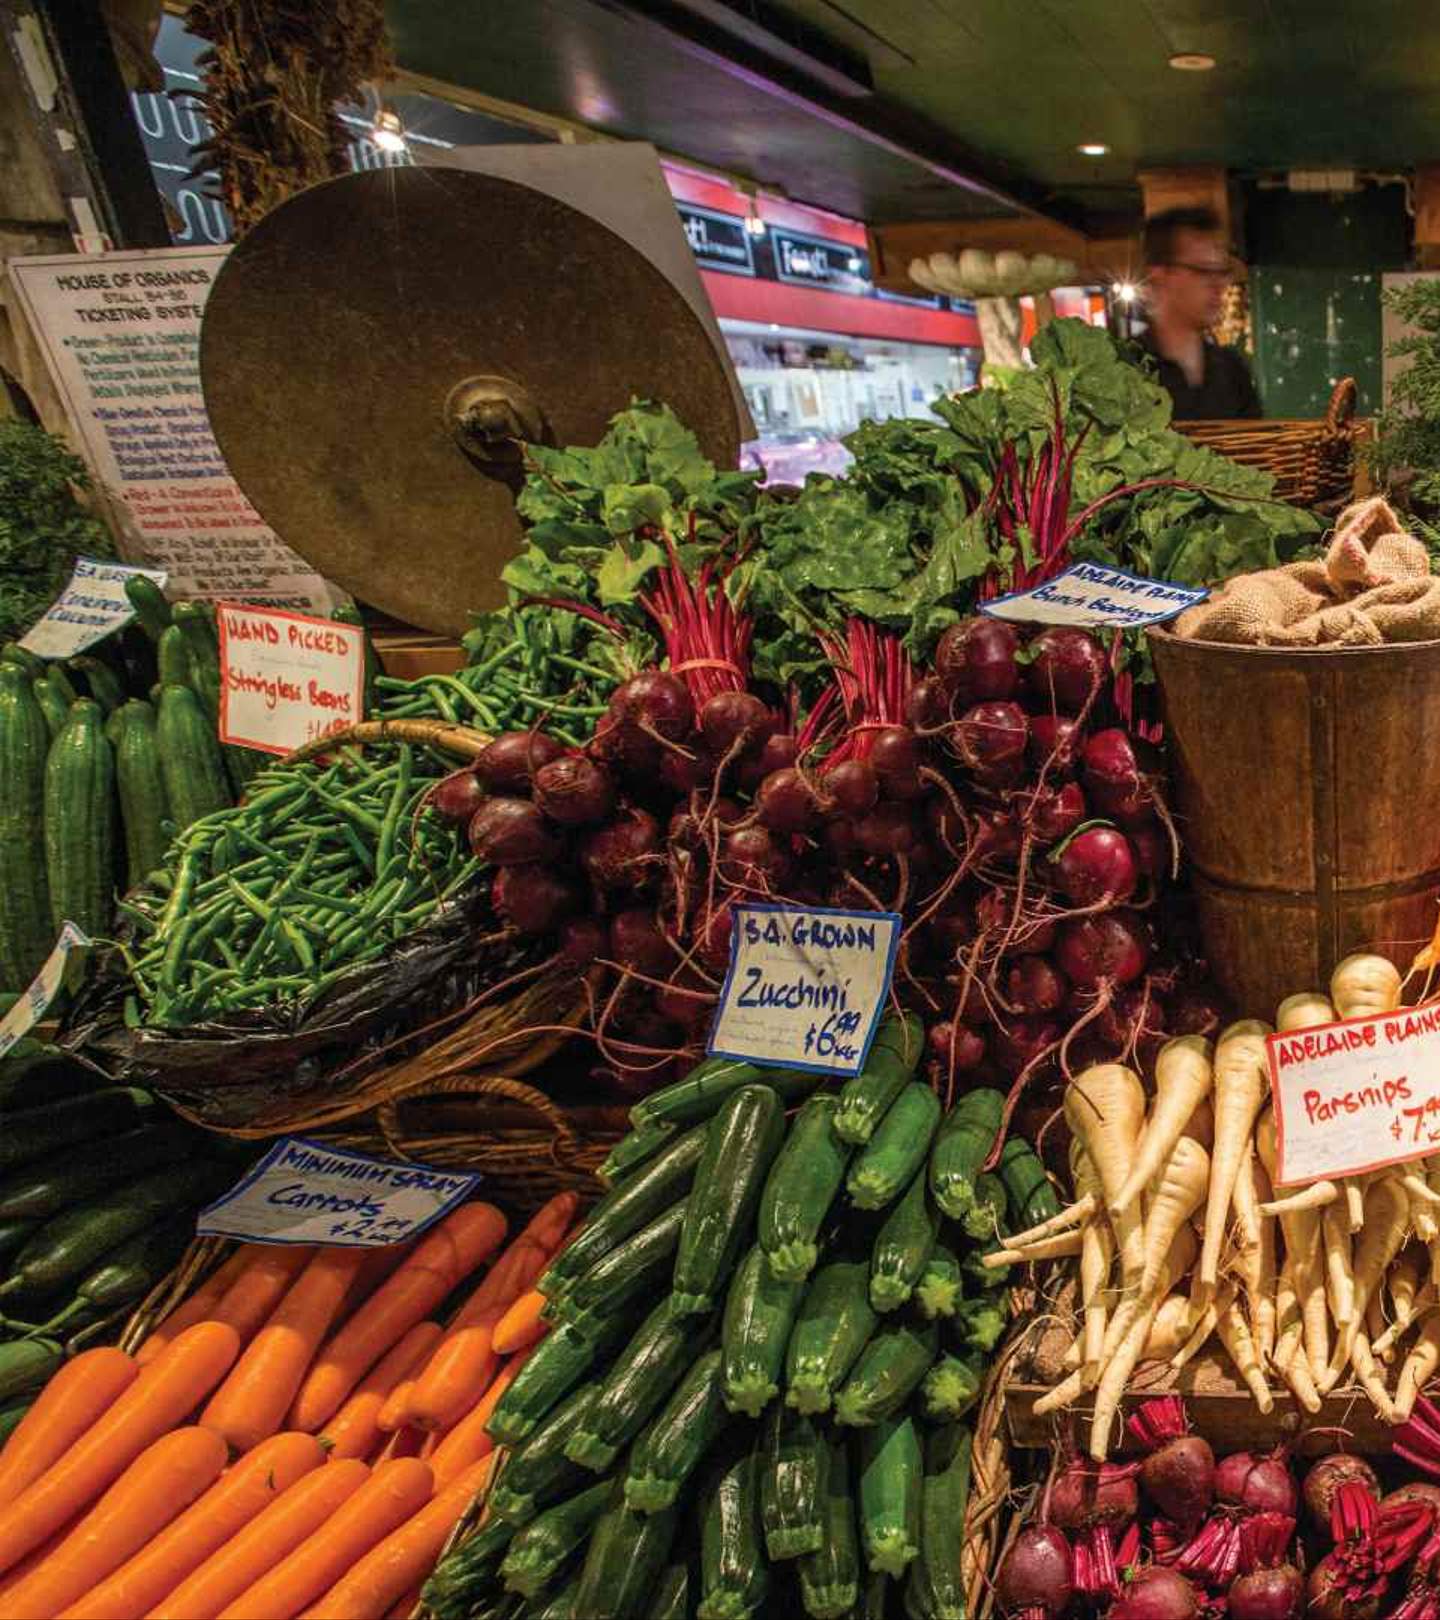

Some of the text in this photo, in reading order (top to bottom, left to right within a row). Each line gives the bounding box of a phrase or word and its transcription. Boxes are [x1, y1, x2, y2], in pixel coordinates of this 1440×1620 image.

[57, 269, 211, 291] HOUSE OF ORGANICS
[75, 304, 206, 323] TICKETING SYSTE
[227, 616, 350, 656] HAND PICKED
[227, 666, 350, 712] Stringless Beans
[792, 917, 876, 951] GROWN
[737, 967, 853, 1012] Zucchini
[1278, 1025, 1377, 1067] ADELAIDE
[1303, 1072, 1412, 1125] Parsnips
[278, 1147, 467, 1193] MINIMUM SPRAY
[267, 1184, 385, 1217] Carrots
